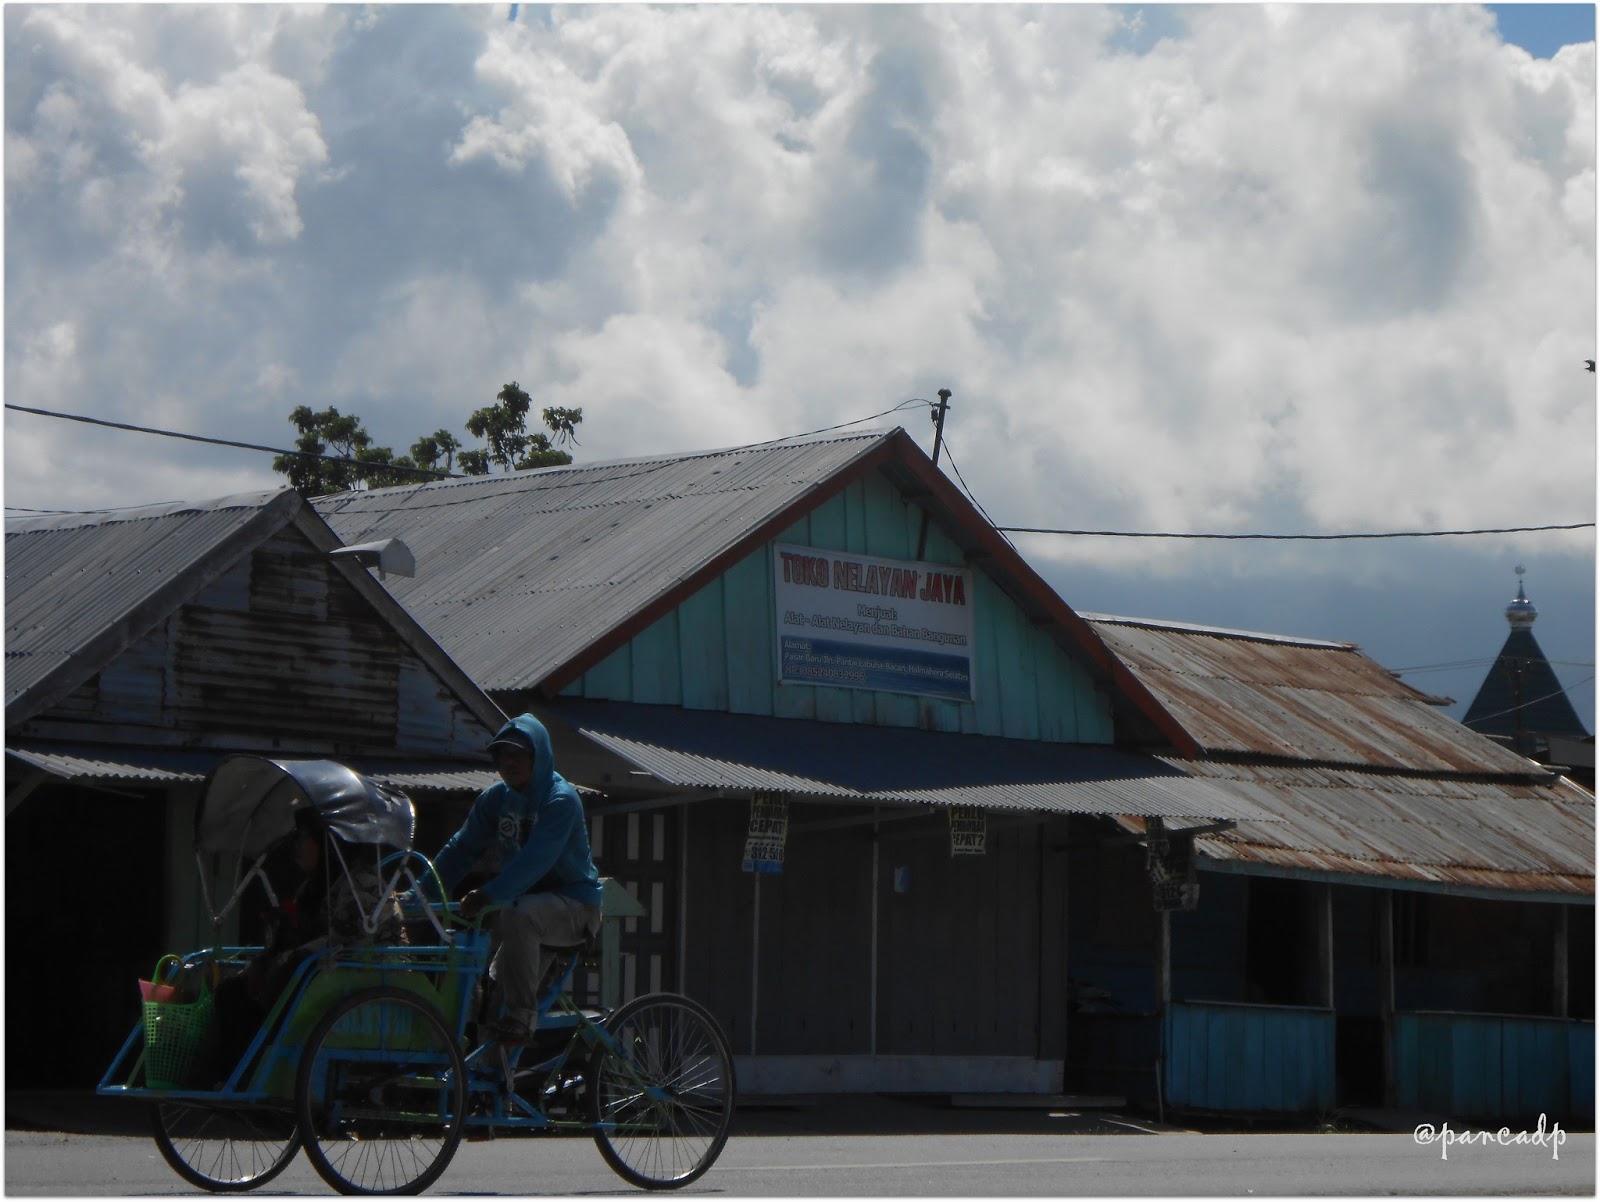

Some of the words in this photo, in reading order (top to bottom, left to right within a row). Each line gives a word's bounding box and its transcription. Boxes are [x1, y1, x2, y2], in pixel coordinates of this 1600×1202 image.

[780, 551, 829, 588] TOKO
[833, 560, 918, 600] NELAYAN
[920, 572, 966, 606] JAYA
[857, 603, 897, 621] Menjual:
[784, 611, 804, 626] Alat
[811, 614, 832, 629] Alat
[832, 617, 870, 634] Nelayan
[871, 621, 890, 636] dan
[891, 624, 920, 640] Bahan
[921, 628, 967, 646] Bangunan
[805, 653, 822, 664] Baru
